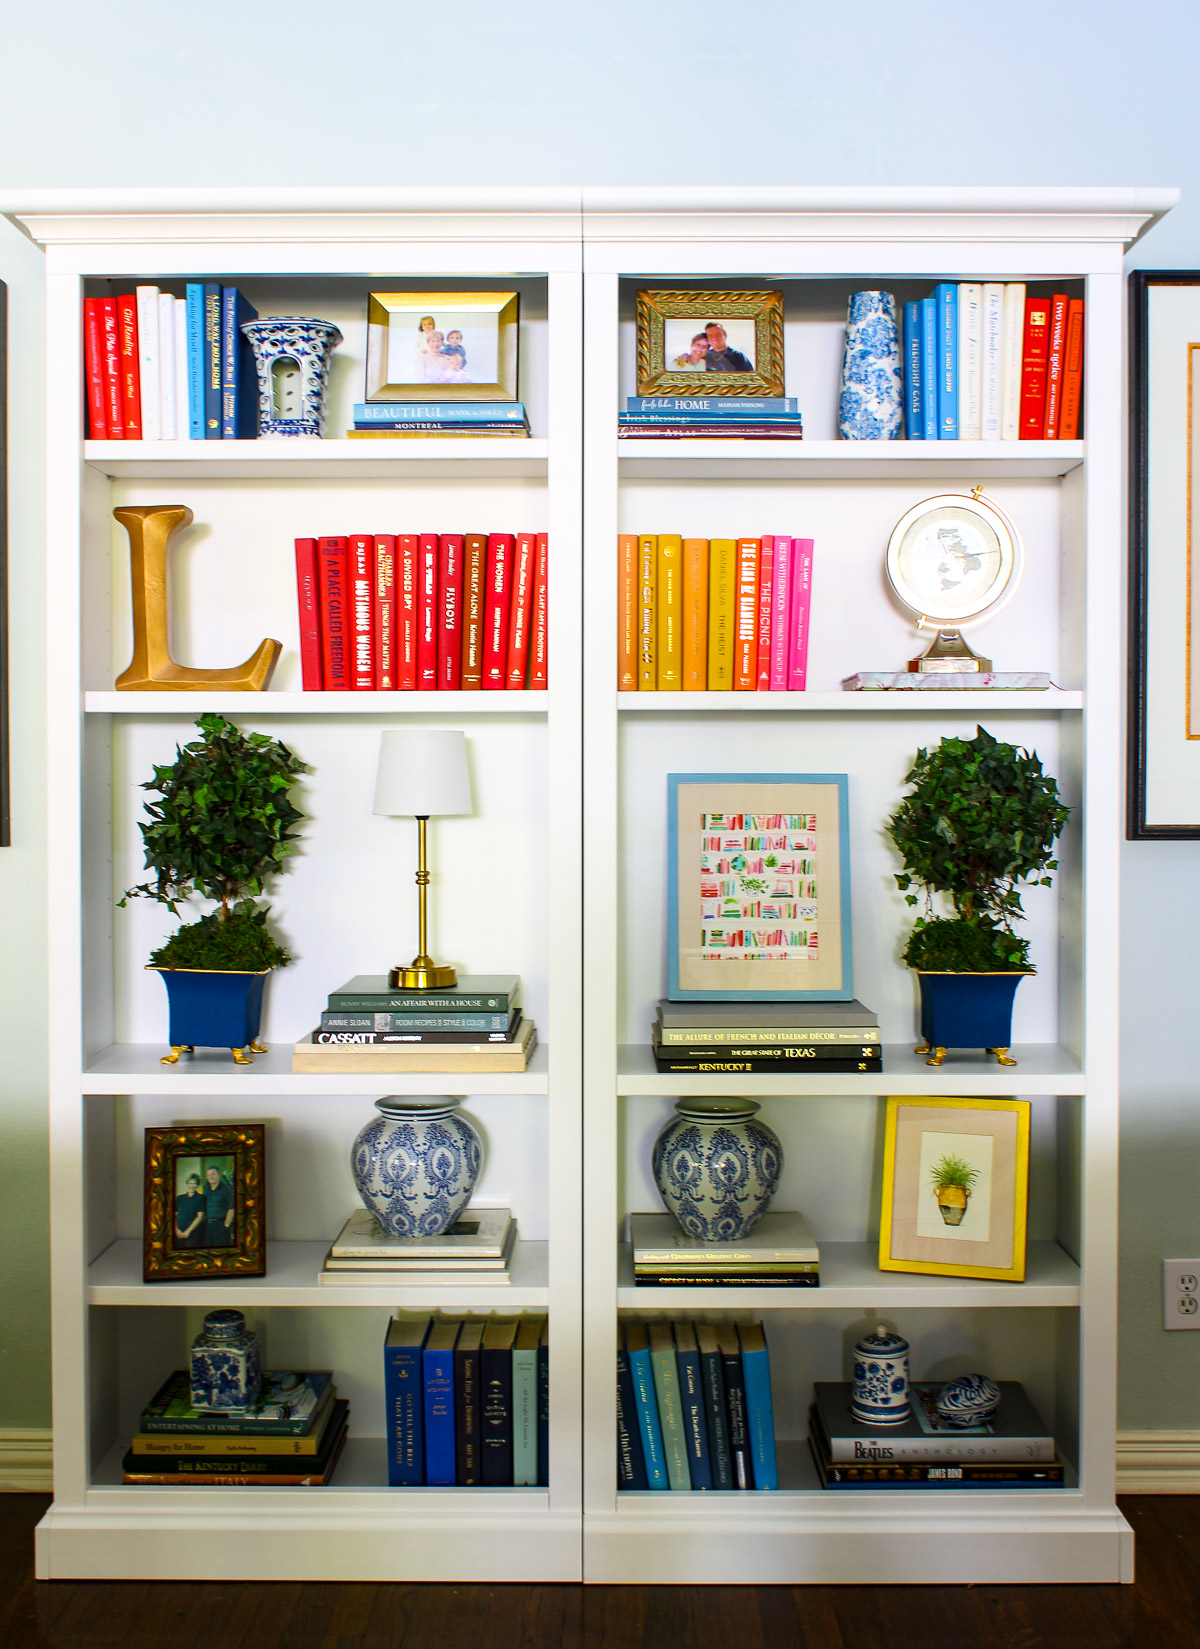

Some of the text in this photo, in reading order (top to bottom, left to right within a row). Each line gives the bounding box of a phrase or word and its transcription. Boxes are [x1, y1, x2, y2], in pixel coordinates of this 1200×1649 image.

[212, 302, 220, 322] LONG
[123, 309, 133, 356] Girl Reading
[212, 326, 220, 340] WAY
[989, 293, 998, 358] The Matchmaker
[1050, 302, 1064, 380] two weeks notice
[212, 343, 220, 363] FROM
[212, 366, 220, 389] HOME
[912, 339, 920, 412] FRIENDSHIP CAKE
[365, 407, 443, 418] BEAUTIFUL
[675, 400, 710, 410] HOME
[742, 544, 756, 558] THE
[495, 544, 504, 592] THE WOMEN
[719, 550, 727, 606] DANIEL SILVA
[741, 562, 756, 581] KING
[777, 543, 787, 610] REESE WITHERSPOON
[328, 569, 340, 596] PLACE
[470, 551, 479, 619] THE GREAT ALONE
[113, 505, 283, 690] L
[355, 580, 370, 631] MUTINOUS
[329, 600, 342, 632] CALLED
[445, 587, 455, 629] FLYBOYS
[760, 582, 770, 645] THE PICNIC
[739, 597, 755, 640] DIAMONDS
[469, 624, 477, 643] Kristin
[330, 636, 344, 678] FREEDOM
[356, 635, 371, 671] WOMEN
[318, 1033, 377, 1044] CASSATT
[669, 1033, 683, 1041] THE
[686, 1033, 713, 1041] ALLURE
[783, 1048, 815, 1058] TEXAS
[699, 1063, 744, 1071] KENTUCKY
[406, 1394, 412, 1406] GO
[639, 1380, 648, 1402] Island
[690, 1405, 698, 1415] The
[147, 1423, 205, 1431] ENTERTAINING
[396, 1426, 402, 1438] AM
[619, 1421, 627, 1432] and
[146, 1443, 172, 1452] Hungry
[620, 1433, 634, 1480] Unknown
[855, 1441, 893, 1460] BEATLES
[177, 1461, 192, 1471] THE
[195, 1461, 238, 1471] KENTUCKY
[928, 1469, 945, 1478] JAMES
[947, 1469, 962, 1478] BOND
[215, 1477, 249, 1486] ITALY
